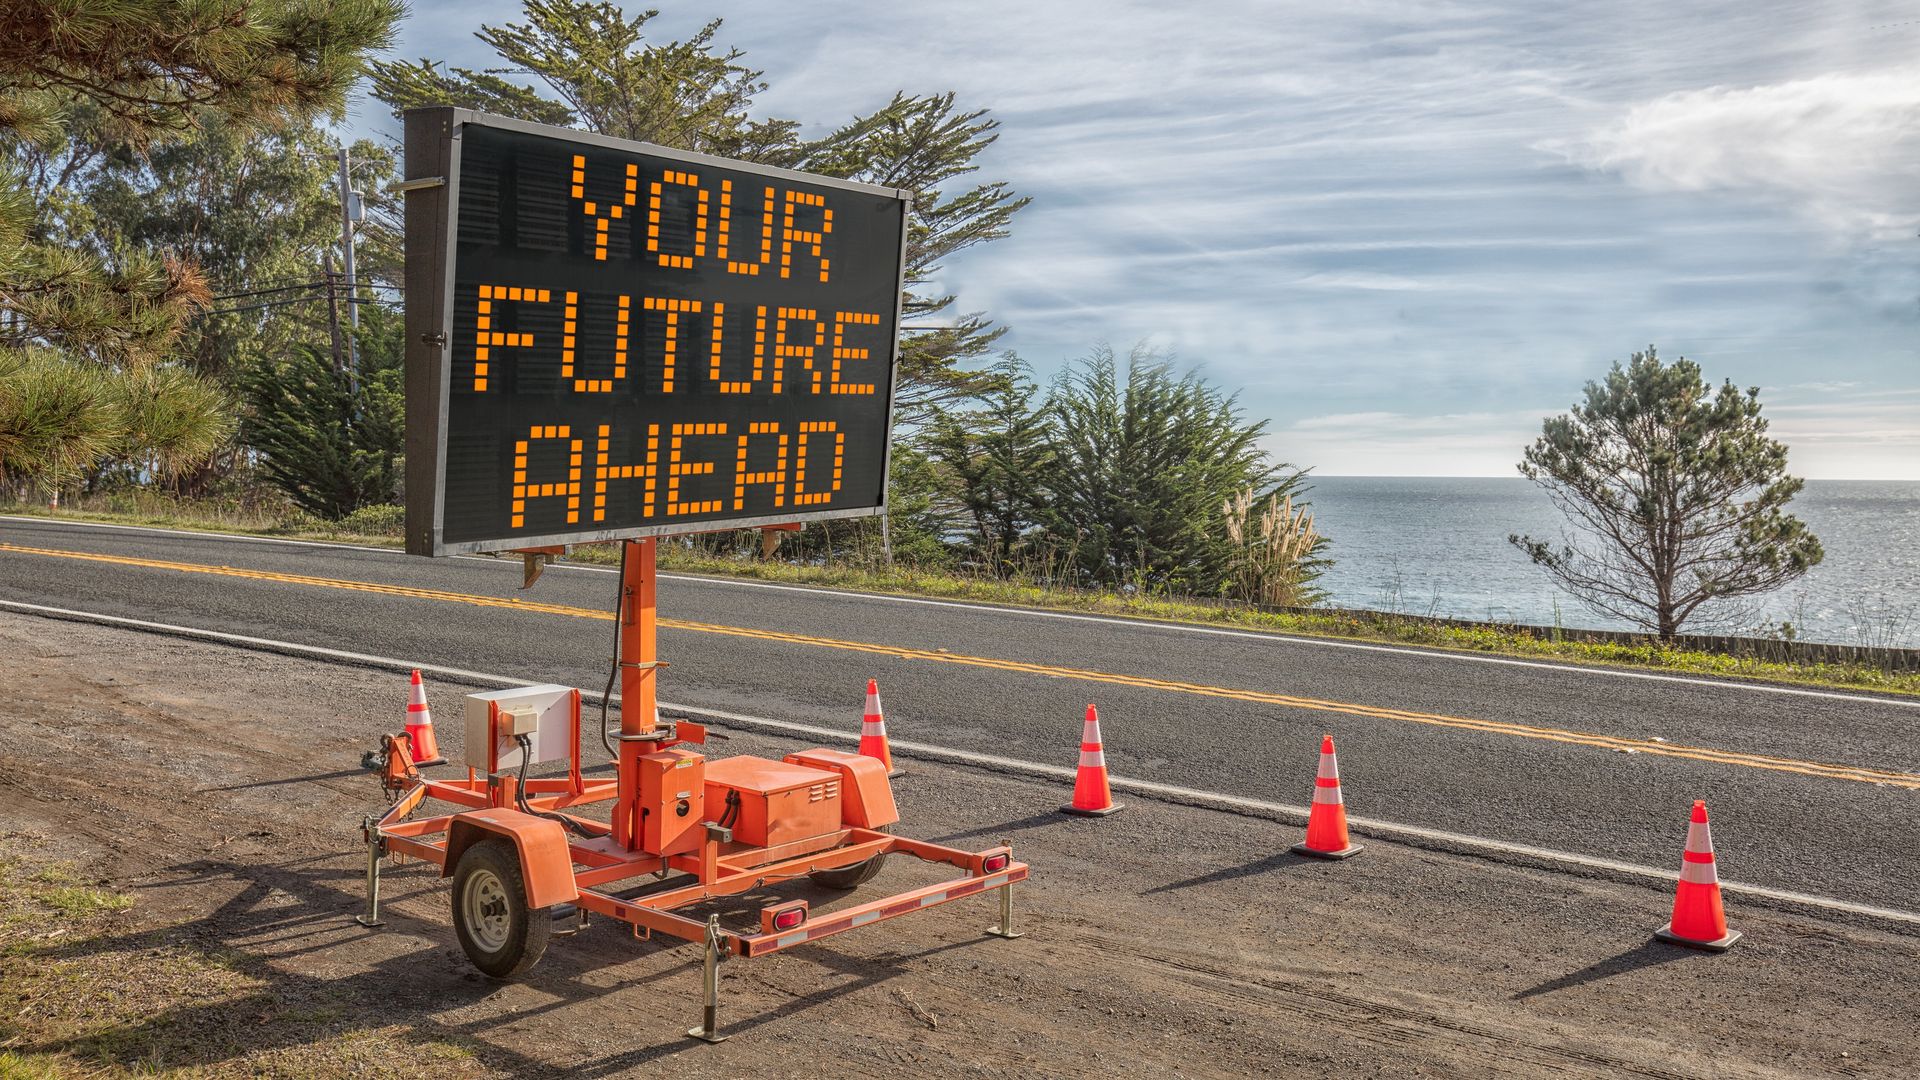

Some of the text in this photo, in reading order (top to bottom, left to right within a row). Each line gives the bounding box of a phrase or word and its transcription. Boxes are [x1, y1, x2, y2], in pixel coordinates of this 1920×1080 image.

[572, 155, 833, 282] YOUR
[474, 285, 880, 394] FUTURE
[511, 421, 844, 528] AHEAD
